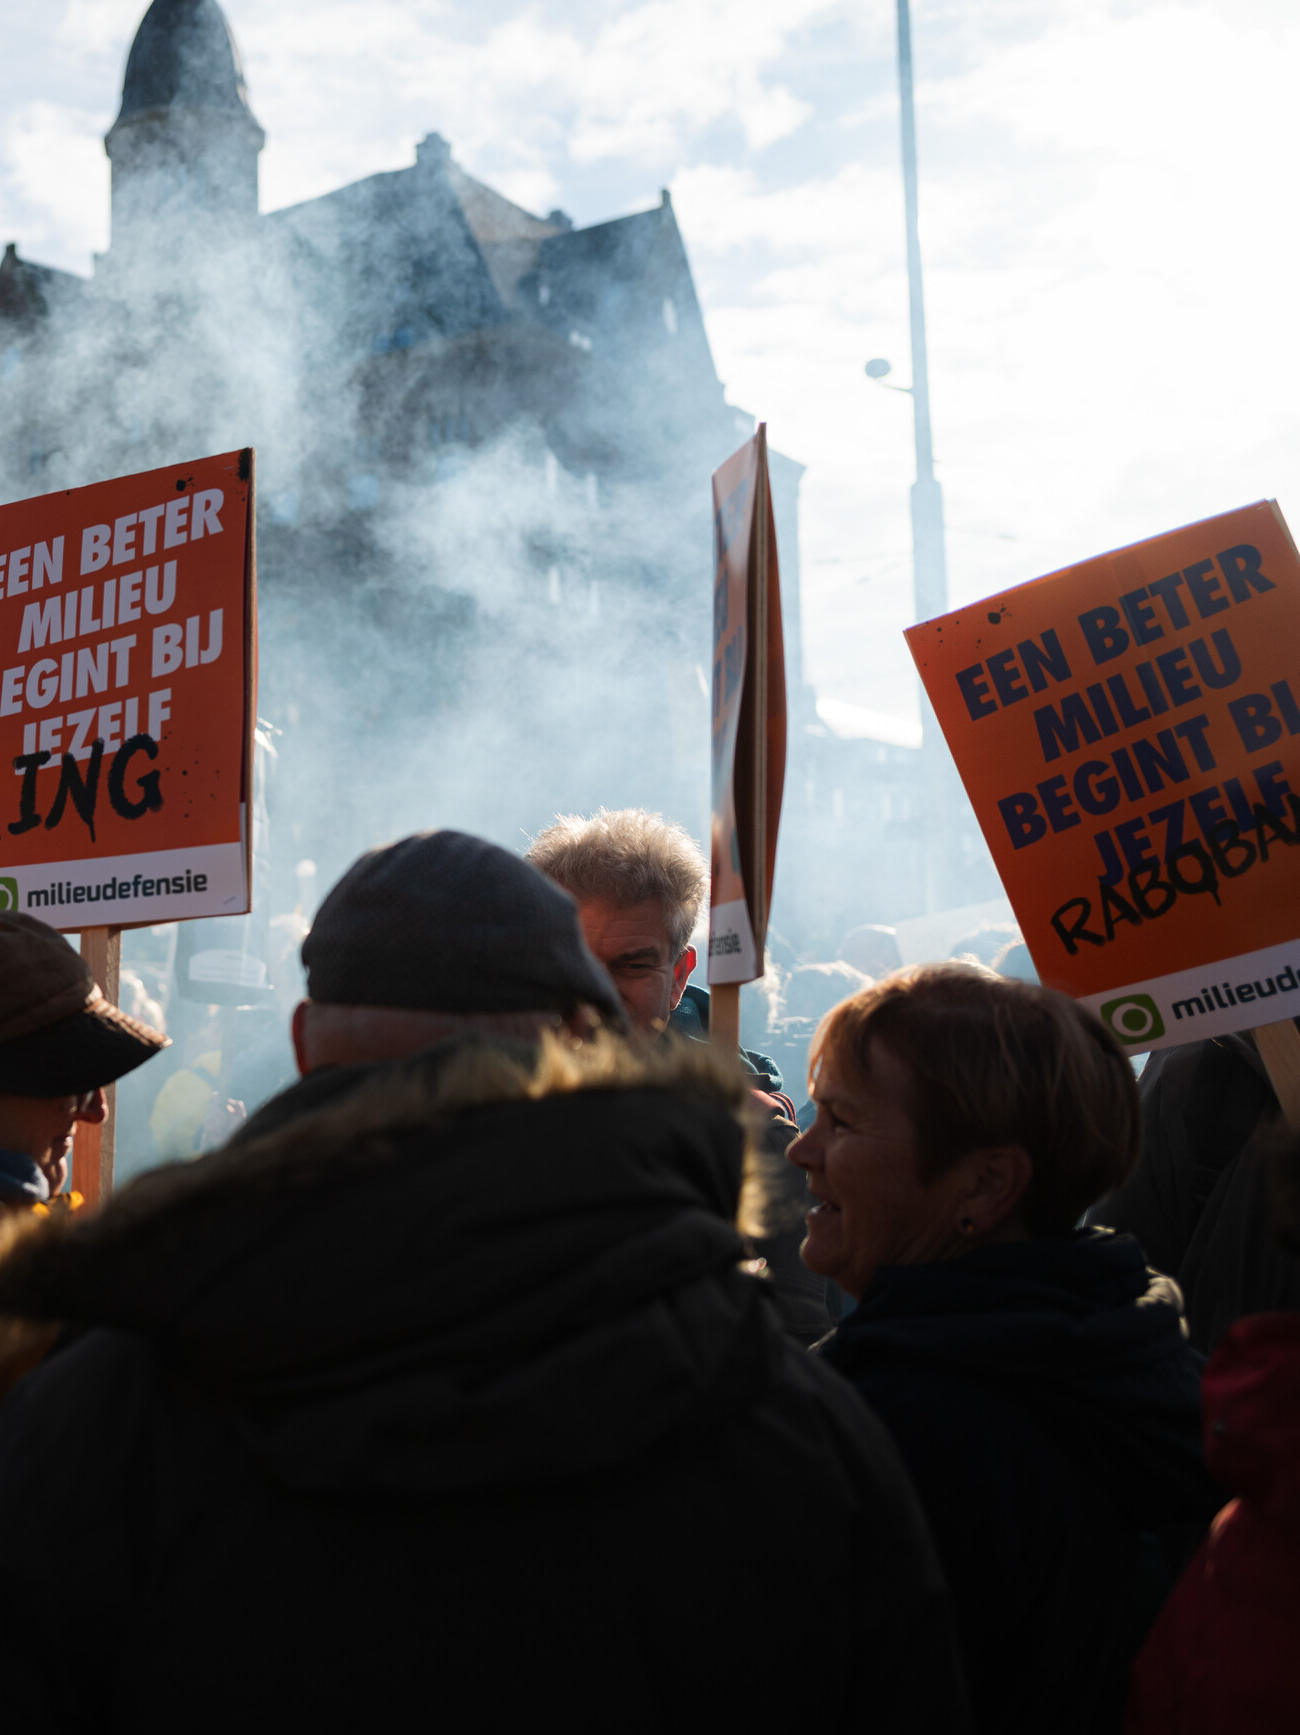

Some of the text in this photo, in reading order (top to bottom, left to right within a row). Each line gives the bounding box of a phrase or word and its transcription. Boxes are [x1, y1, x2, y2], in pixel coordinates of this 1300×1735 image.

[80, 488, 224, 576] BETER
[17, 559, 177, 654] MILIEU
[151, 608, 224, 679] BIJ
[955, 544, 1277, 722] EEN BETER
[1033, 627, 1242, 763] MILIEU
[7, 733, 164, 843] ING
[997, 713, 1217, 851] BEGINT
[1093, 760, 1292, 887] JEZELF
[27, 868, 208, 908] milieudefensie
[1171, 965, 1300, 1021] milieud
